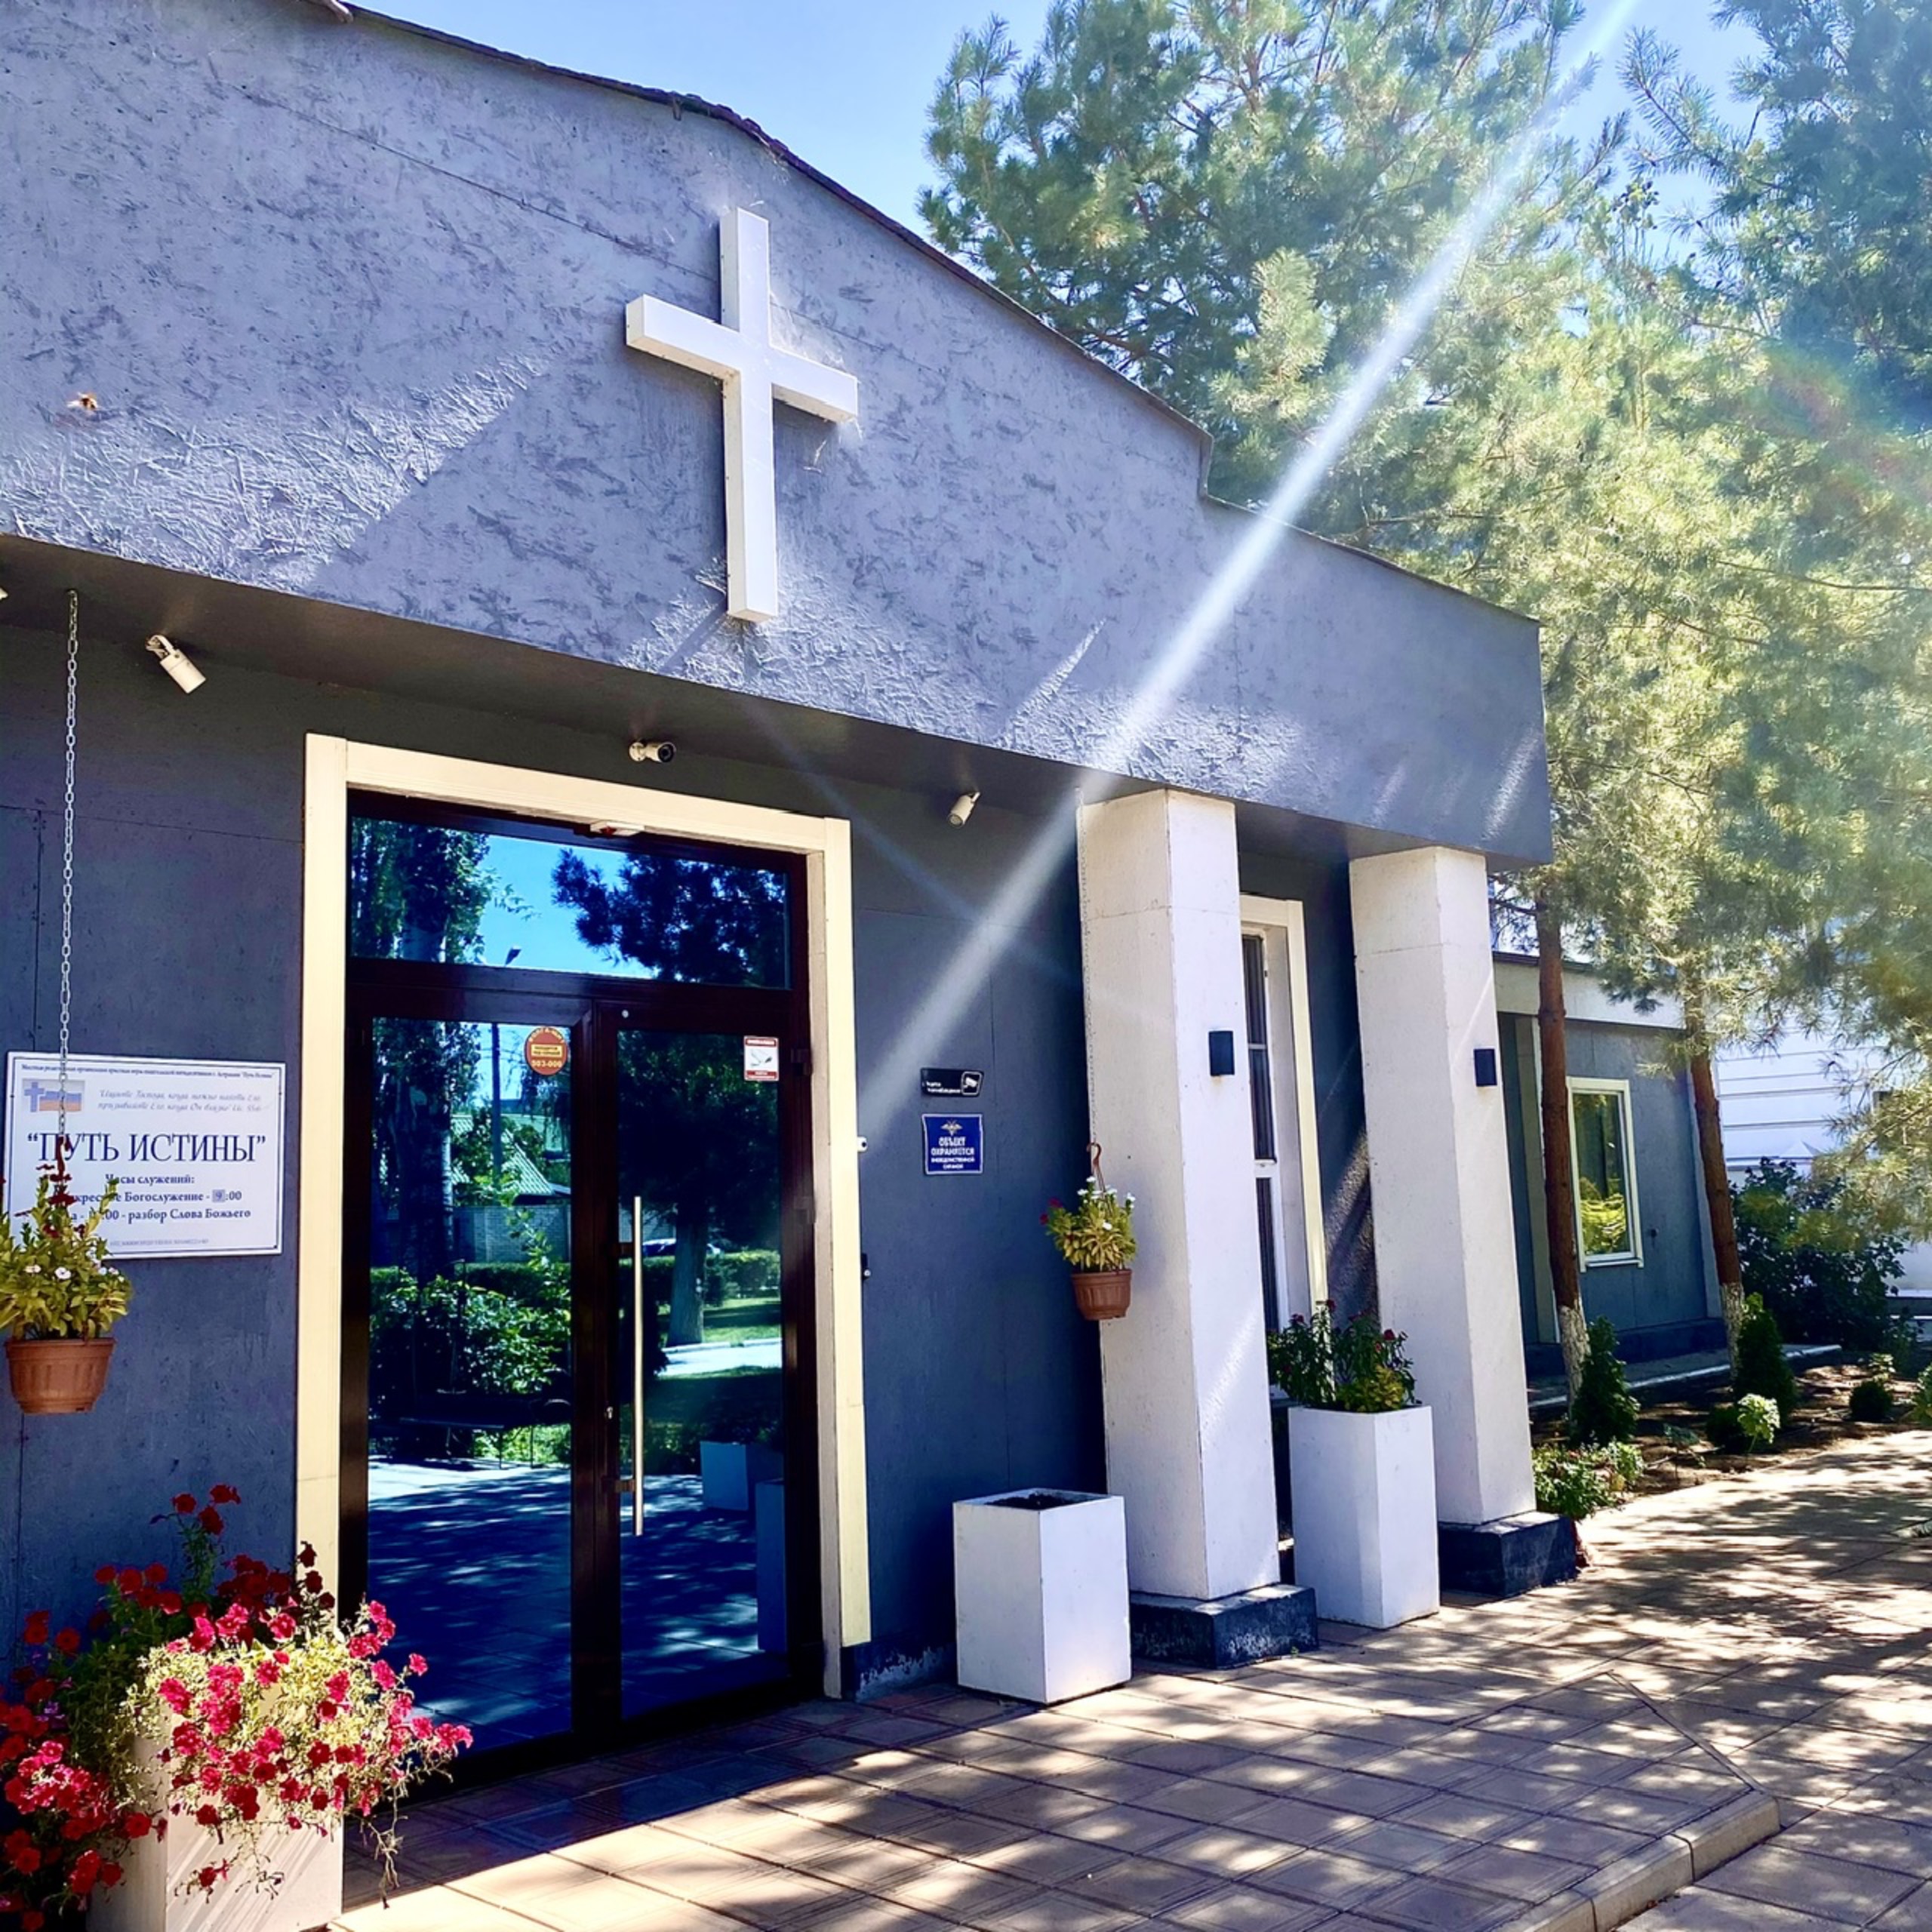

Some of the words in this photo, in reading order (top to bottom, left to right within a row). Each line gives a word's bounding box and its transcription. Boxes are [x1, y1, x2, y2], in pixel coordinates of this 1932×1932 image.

[106, 1174, 135, 1184] Чсы
[137, 1175, 195, 1186] служений:
[125, 1192, 204, 1204] Богослужение
[214, 1190, 242, 1201] 9:00
[128, 1209, 168, 1224] разбор
[170, 1209, 202, 1220] Слова
[205, 1208, 251, 1219] Божьего
